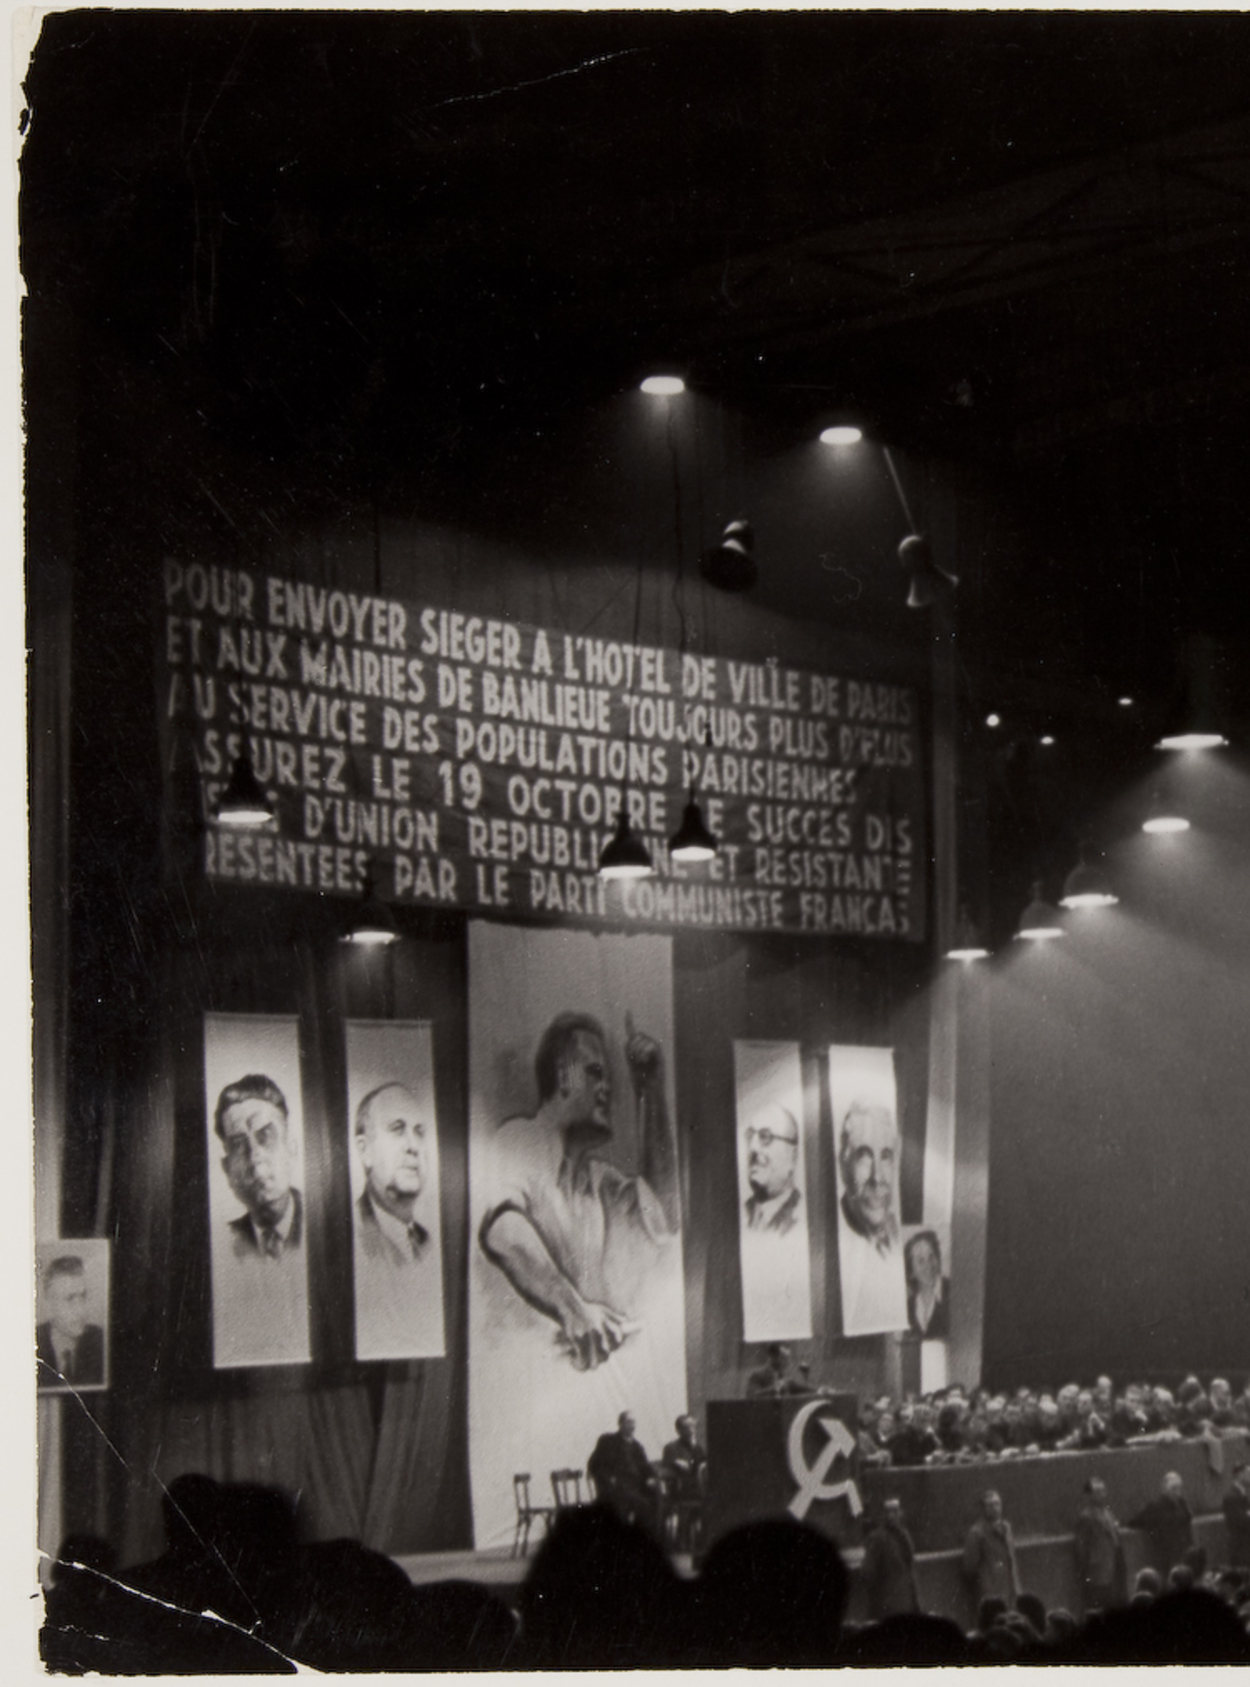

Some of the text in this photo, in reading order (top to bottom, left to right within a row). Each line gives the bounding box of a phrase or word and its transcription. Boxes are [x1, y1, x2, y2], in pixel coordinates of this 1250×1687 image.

[162, 556, 912, 725] POUR ENVOYER SIEGER A L'HOTEL DE VILLE DE PARIS
[166, 614, 202, 664] ET
[216, 624, 289, 680] AUX
[300, 637, 426, 703] MAIRIES
[437, 663, 473, 713] DE
[482, 669, 610, 734] BANLIEUE
[622, 693, 759, 752] TOUJOURS
[769, 712, 830, 760] PLUS
[228, 680, 367, 744] SERVICE
[383, 705, 440, 754] DES
[456, 717, 669, 786] POPULATIONS
[304, 793, 439, 852] D'UNION
[709, 842, 740, 882] ET
[372, 753, 411, 802] LE
[438, 759, 483, 810] 19
[746, 802, 853, 847] SUCCES
[394, 854, 457, 902] PAR
[477, 863, 509, 906] LE
[529, 867, 606, 916] PARTI
[621, 880, 784, 929] COMMUNISTE
